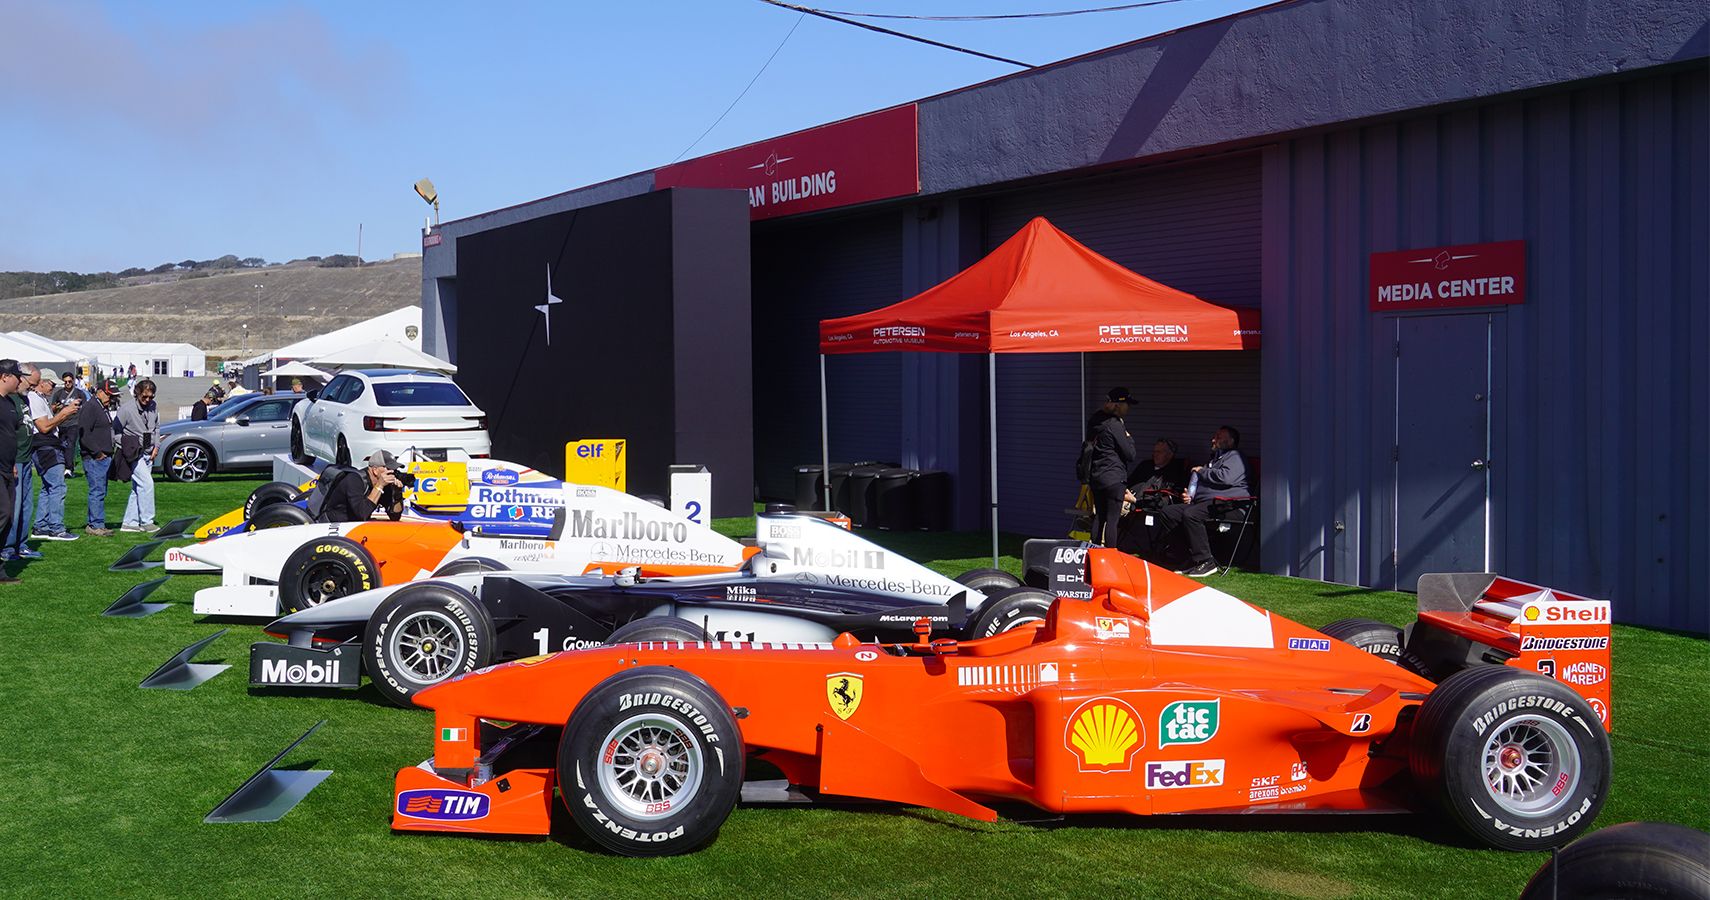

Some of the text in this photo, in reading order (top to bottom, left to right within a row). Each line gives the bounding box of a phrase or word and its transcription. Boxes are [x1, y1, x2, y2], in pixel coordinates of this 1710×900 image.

[772, 170, 836, 204] BUILDING
[1378, 276, 1515, 302] MEDIA CENTER
[873, 326, 926, 337] PETERSEN
[1009, 330, 1021, 338] Los
[1099, 325, 1188, 336] PETERSEN
[577, 444, 603, 457] elf
[470, 505, 502, 518] elf
[685, 501, 701, 524] 2
[572, 510, 687, 543] Marlboro
[499, 540, 544, 550] Marlboro
[617, 544, 724, 564] Mercedes-Benz
[794, 547, 858, 569] Mobil
[727, 586, 756, 595] Mika
[825, 574, 951, 596] Mercedes-Benz
[1546, 606, 1607, 621] Shell
[533, 628, 549, 656] 1
[1290, 639, 1329, 650] FIAT
[1522, 637, 1608, 650] BRIDGESTONE
[375, 623, 409, 694] POTENZA
[262, 659, 339, 683] Mobil
[1538, 660, 1556, 680] 3
[619, 692, 719, 743] BRIDGESTONE
[1173, 703, 1209, 724] tic
[1472, 695, 1574, 737] BRIDGESTONE
[1166, 718, 1209, 740] tac
[604, 738, 619, 766] BBS
[1148, 762, 1220, 787] FedEx
[1251, 775, 1281, 787] SKF
[1552, 772, 1569, 796] BBS
[1249, 787, 1279, 799] arexons
[443, 796, 482, 815] TIM
[645, 800, 671, 814] BBS
[583, 792, 685, 842] POTENZA
[1494, 797, 1592, 838] POTENZA
